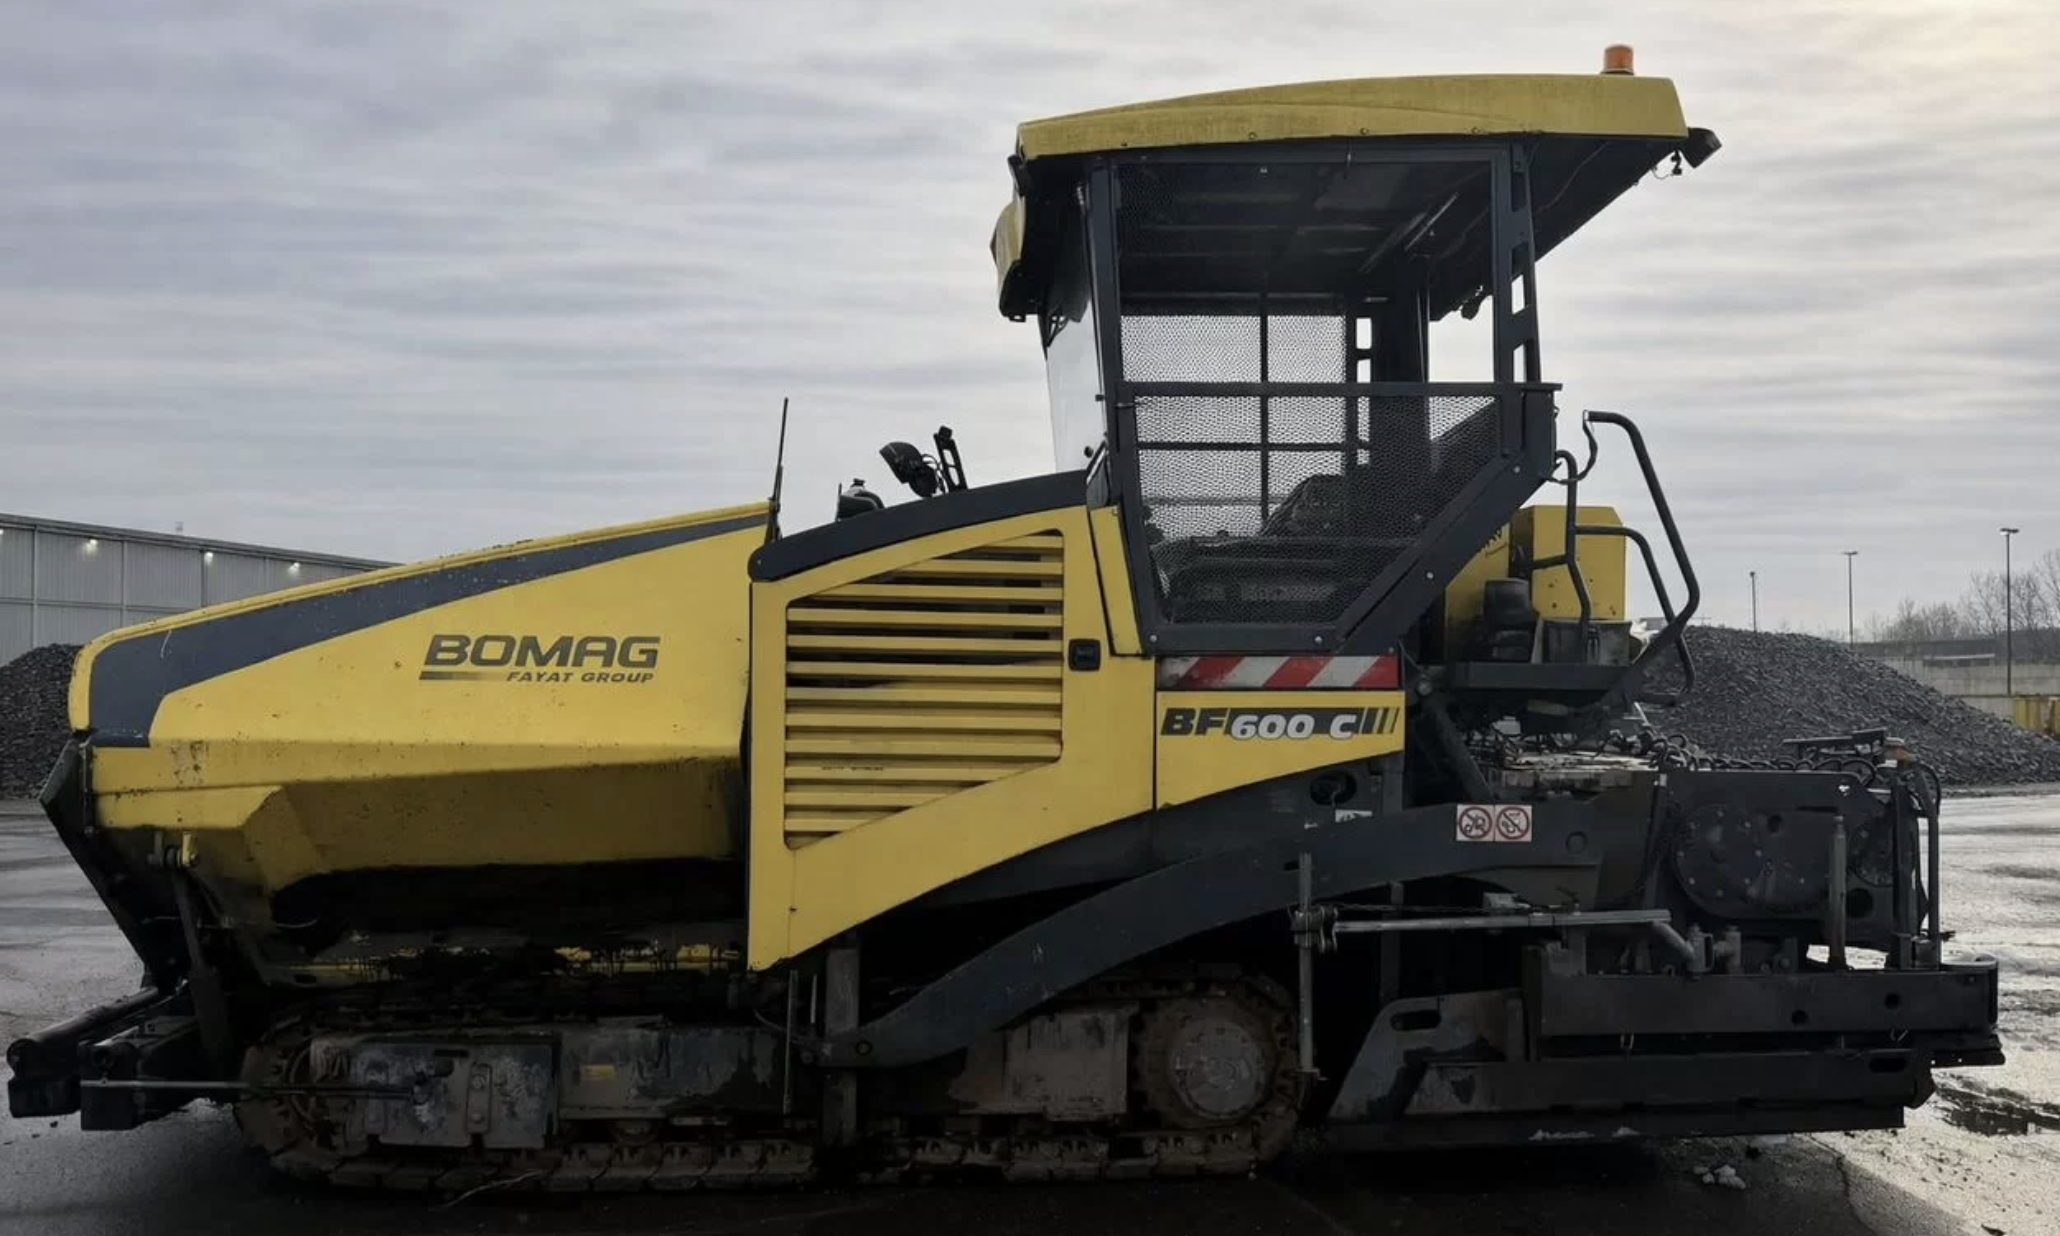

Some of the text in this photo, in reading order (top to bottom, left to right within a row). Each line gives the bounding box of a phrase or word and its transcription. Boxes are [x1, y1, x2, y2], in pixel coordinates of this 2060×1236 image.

[424, 634, 661, 668] BOMAG
[506, 671, 655, 684] FAYAT GROUP
